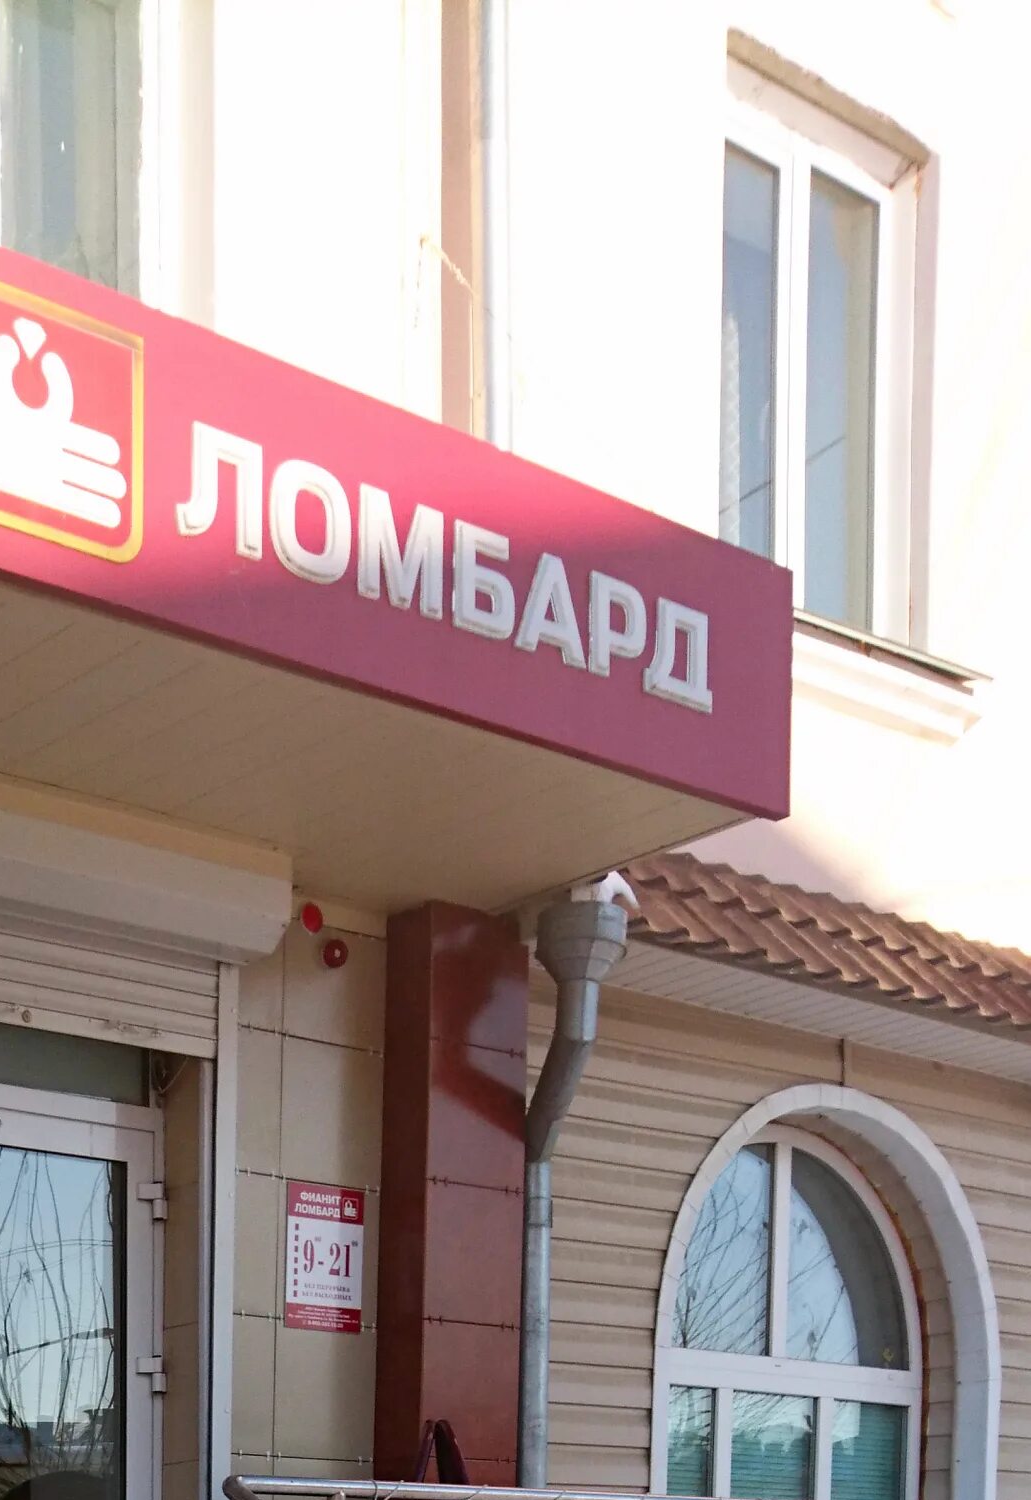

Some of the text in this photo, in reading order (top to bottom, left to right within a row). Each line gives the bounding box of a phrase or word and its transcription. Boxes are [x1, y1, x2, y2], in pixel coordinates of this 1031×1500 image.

[176, 421, 713, 714] ЛОМБАРД
[300, 1191, 341, 1205] ФИАНИТ
[294, 1203, 341, 1218] ЛОМБАРД
